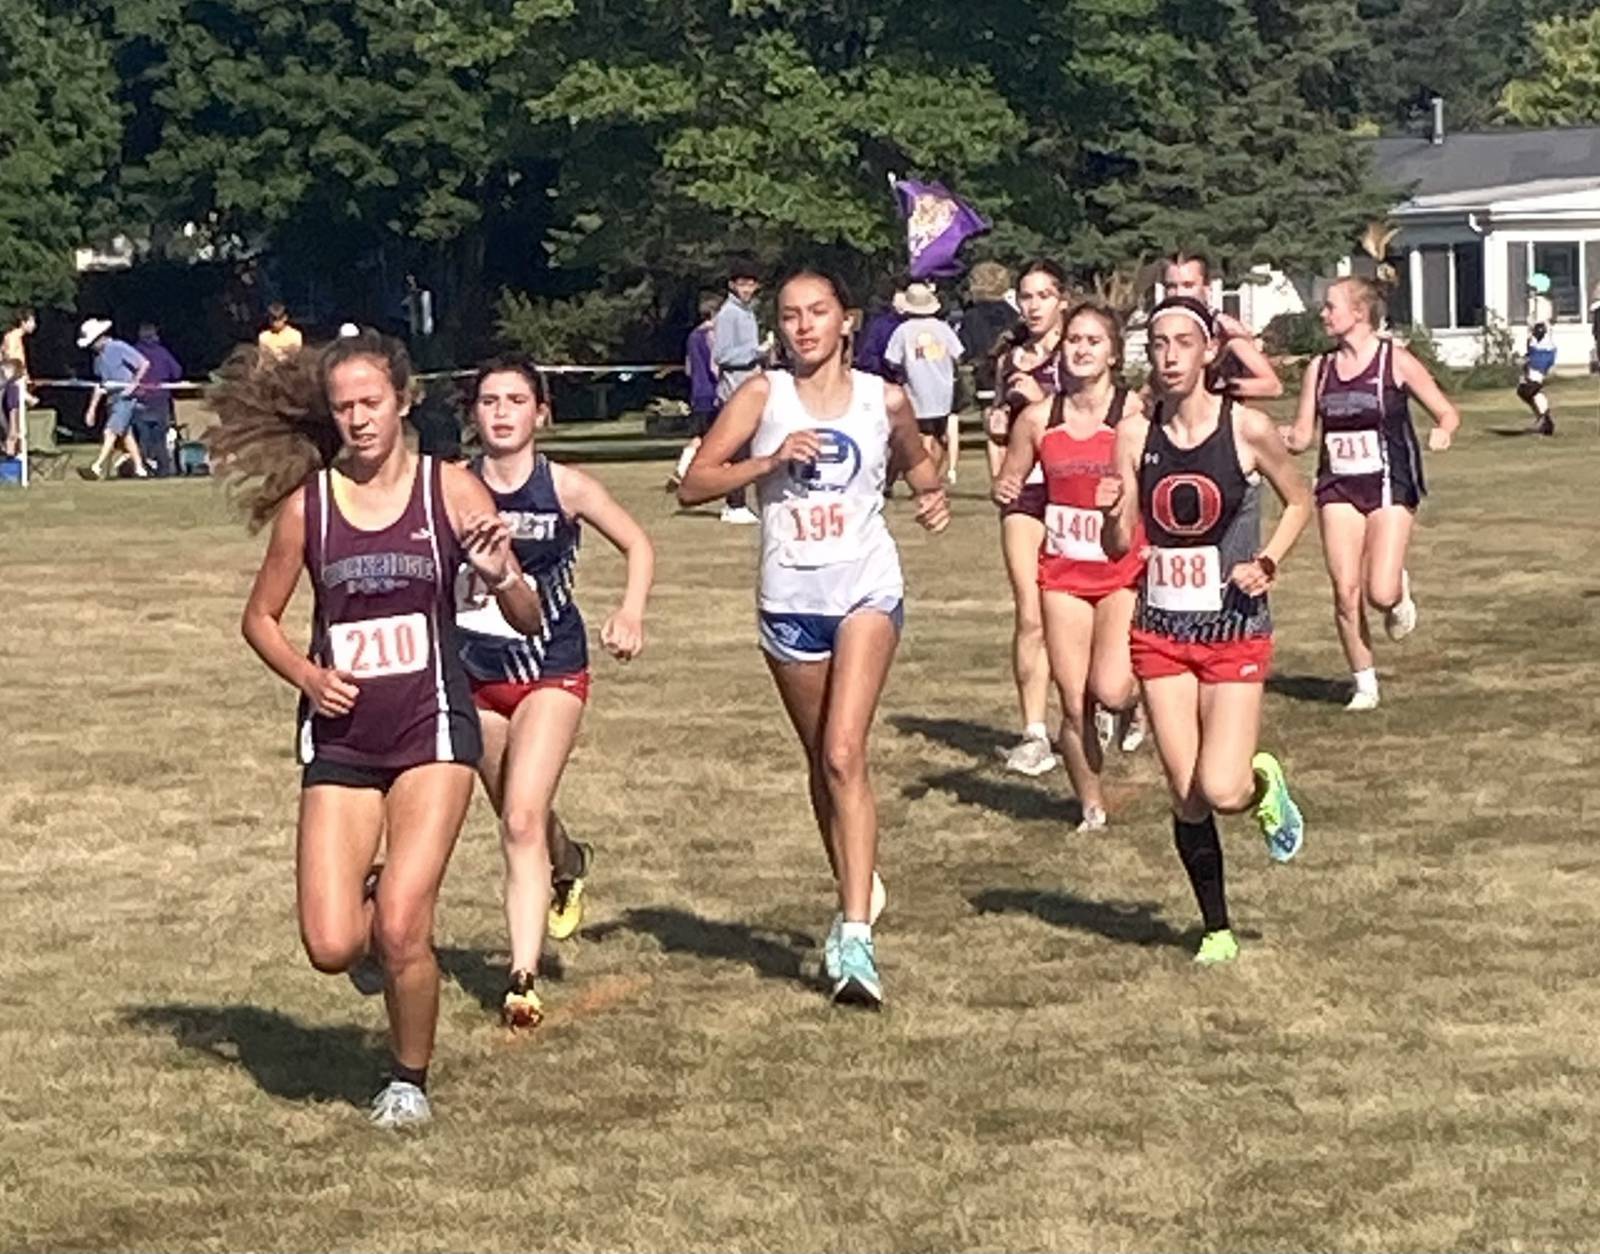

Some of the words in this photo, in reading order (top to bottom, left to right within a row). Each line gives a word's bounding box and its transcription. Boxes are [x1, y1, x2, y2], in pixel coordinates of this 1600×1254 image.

[1331, 434, 1371, 460] 211
[790, 502, 845, 542] 195
[1152, 472, 1222, 536] O
[1056, 510, 1097, 544] 140
[1154, 553, 1207, 589] 188
[346, 623, 416, 672] 210
